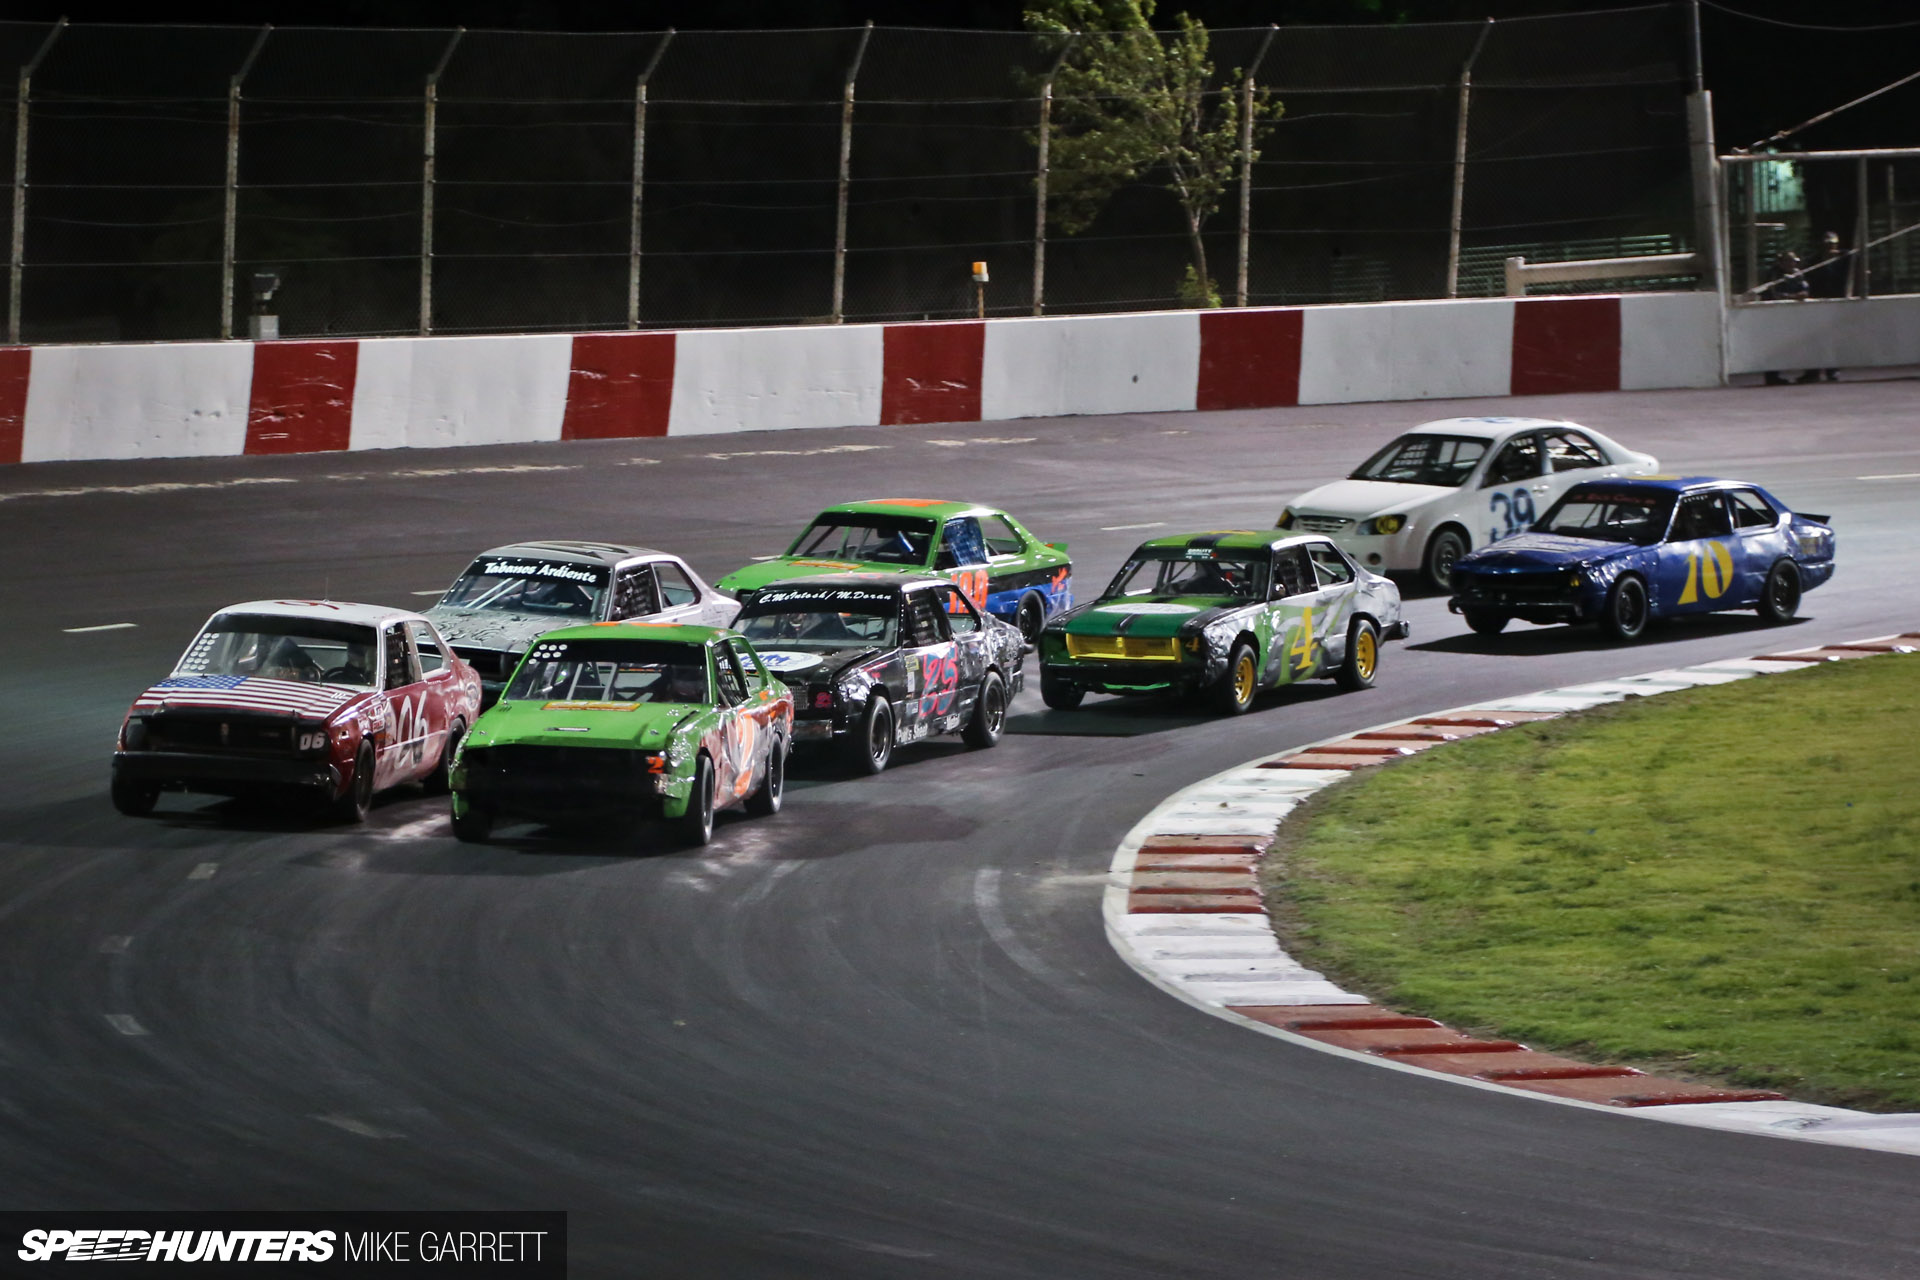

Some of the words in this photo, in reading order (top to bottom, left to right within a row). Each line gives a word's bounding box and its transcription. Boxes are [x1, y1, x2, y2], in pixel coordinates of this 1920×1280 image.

[1488, 488, 1535, 544] 39
[484, 561, 536, 575] Tabanos
[536, 564, 597, 584] Ardiente
[1678, 541, 1734, 605] 10
[1185, 636, 1199, 651] 4
[1290, 606, 1318, 670] 4
[299, 733, 326, 751] 06
[395, 690, 429, 769] 06
[645, 755, 665, 774] 2
